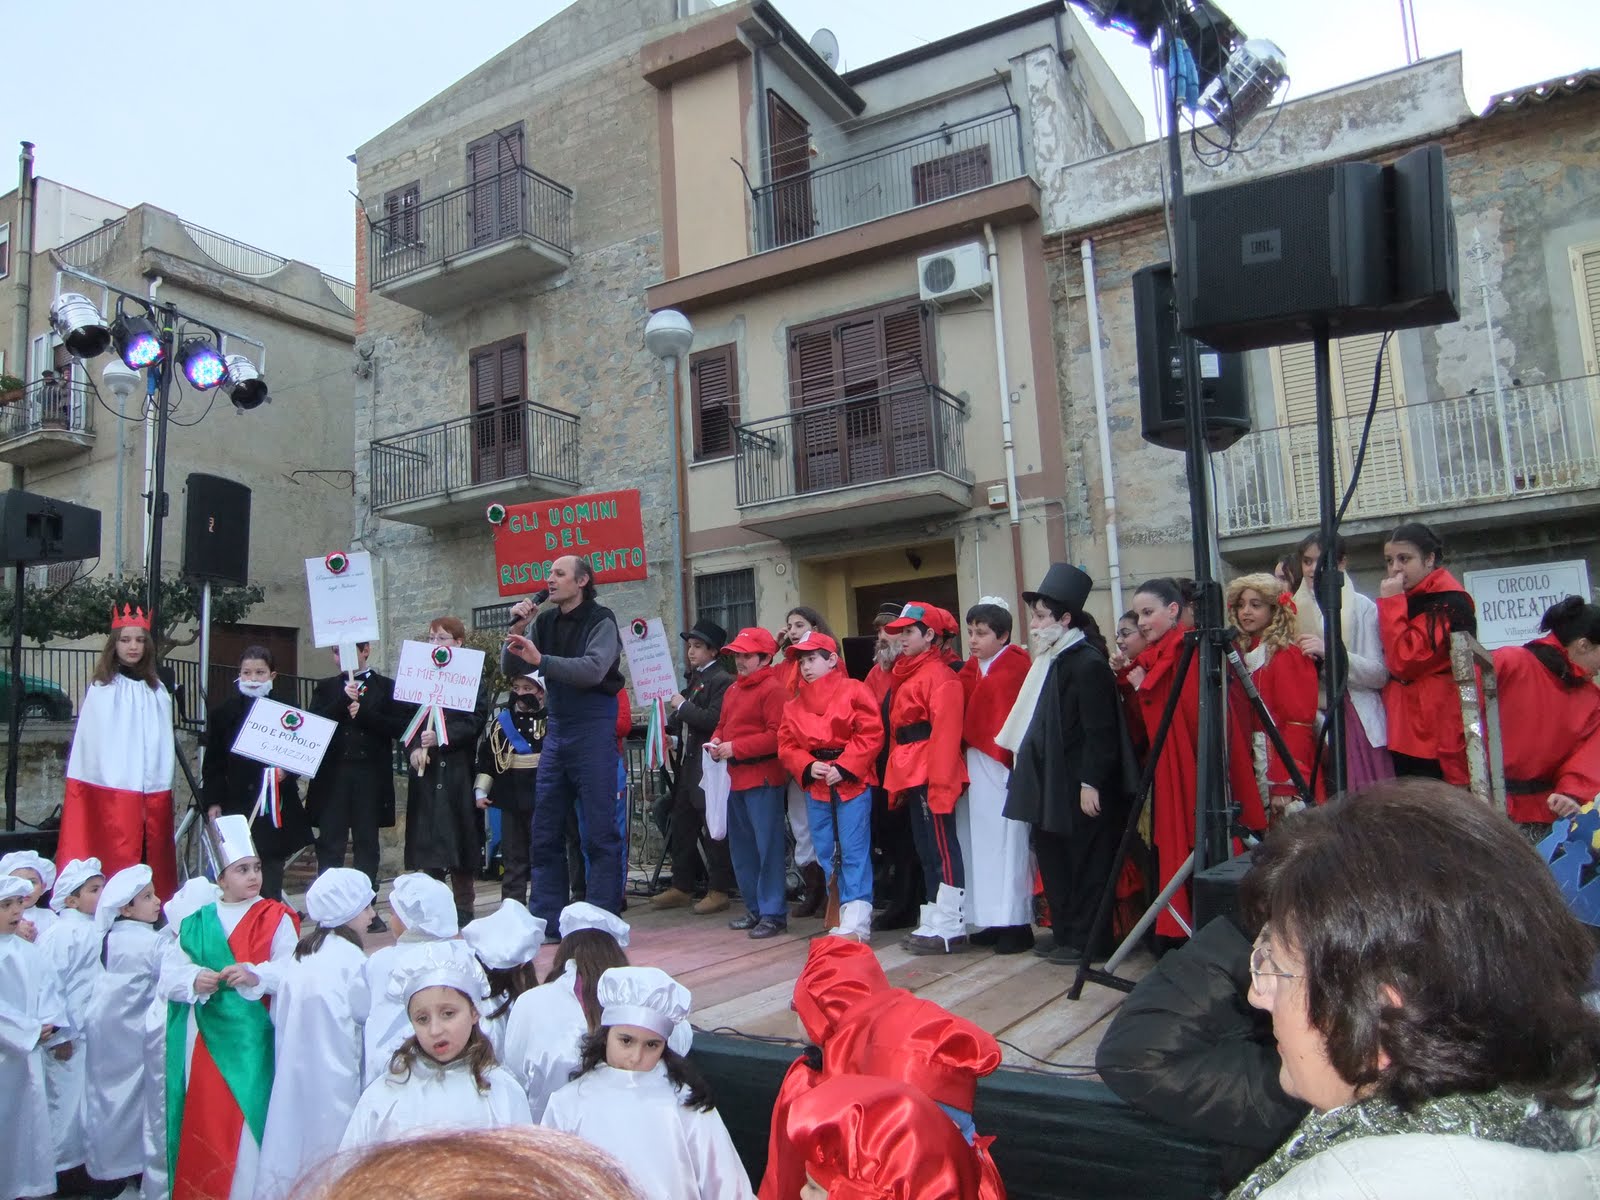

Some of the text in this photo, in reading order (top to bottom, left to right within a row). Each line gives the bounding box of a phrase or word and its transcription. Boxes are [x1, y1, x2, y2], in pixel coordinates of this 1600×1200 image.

[1251, 240, 1274, 256] JBL
[509, 500, 617, 533] GLI UOMINI
[545, 528, 589, 550] DEL
[500, 547, 643, 586] RISORENTO
[1497, 575, 1550, 593] CIRCOLO
[1482, 592, 1573, 622] RICREATI
[399, 667, 478, 687] LE MIE PRIGIONI
[394, 687, 473, 709] SILVIO PELLICO
[434, 683, 444, 693] DI
[269, 728, 277, 737] E
[271, 745, 316, 764] MAZZINI
